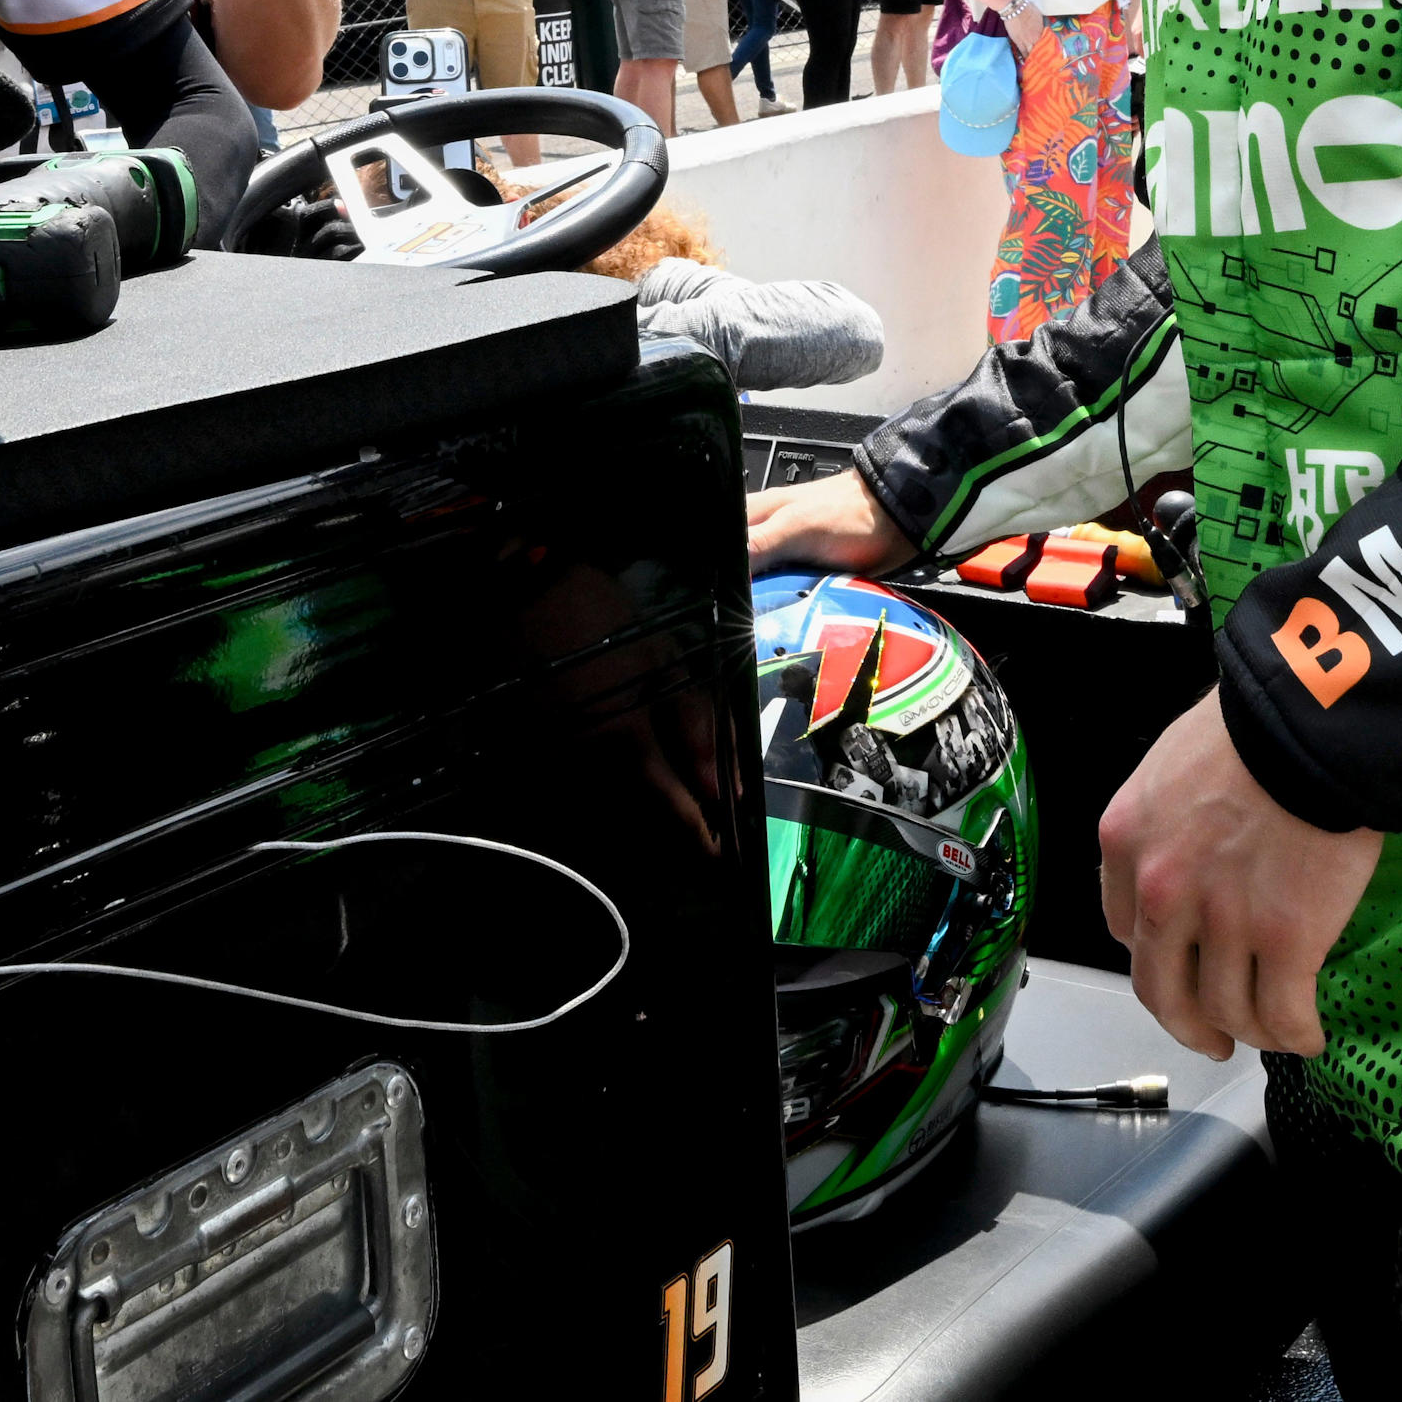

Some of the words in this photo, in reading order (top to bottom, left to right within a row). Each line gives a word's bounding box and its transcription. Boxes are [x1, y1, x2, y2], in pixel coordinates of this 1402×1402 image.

[539, 19, 572, 43] KEEP
[541, 41, 572, 64] INDY
[777, 449, 816, 461] FORWARD
[943, 843, 971, 869] BELL
[660, 1238, 733, 1402] 19
